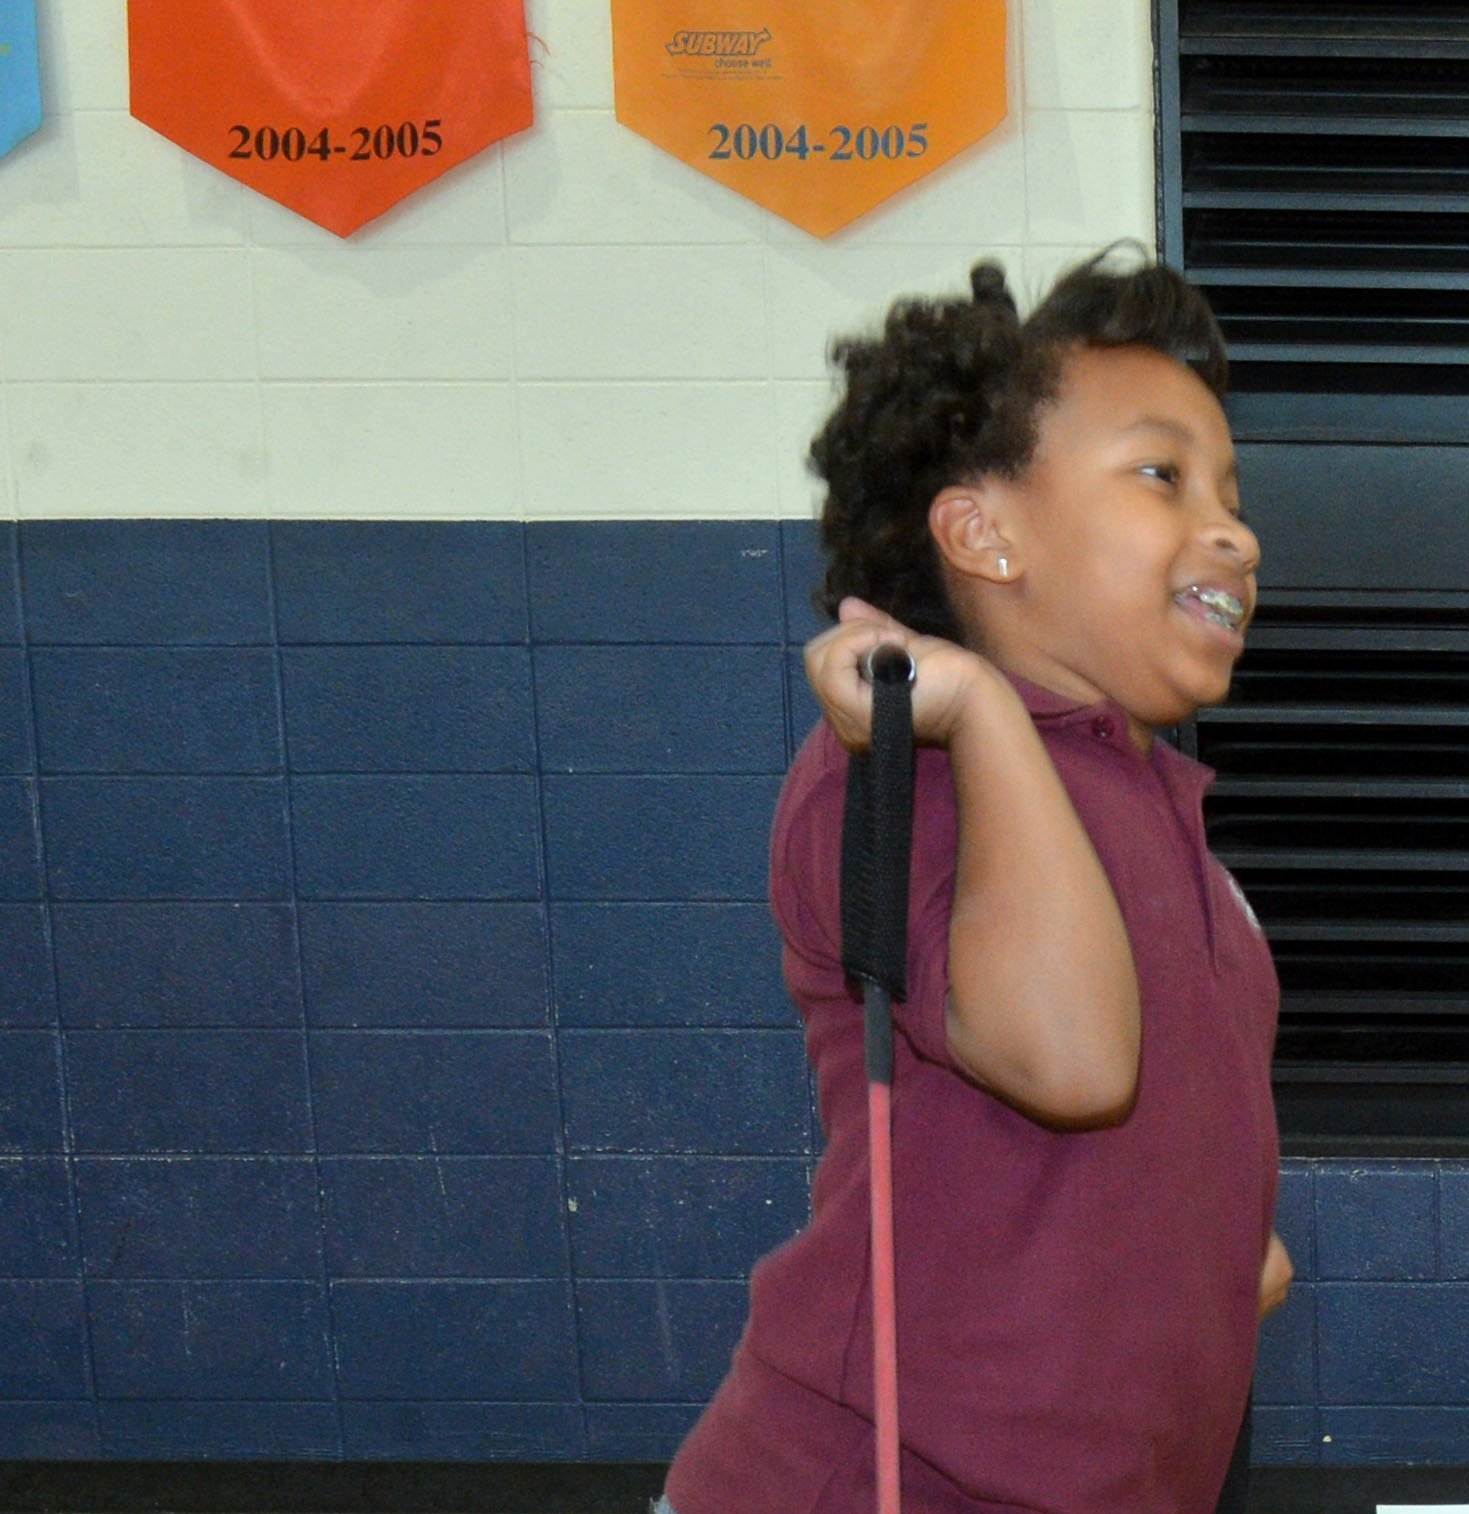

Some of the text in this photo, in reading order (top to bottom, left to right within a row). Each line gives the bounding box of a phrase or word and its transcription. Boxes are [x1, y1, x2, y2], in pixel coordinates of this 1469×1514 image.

[665, 27, 772, 56] SUBWAY
[228, 119, 443, 161] 2004-2005
[707, 123, 929, 160] 2004-2005
